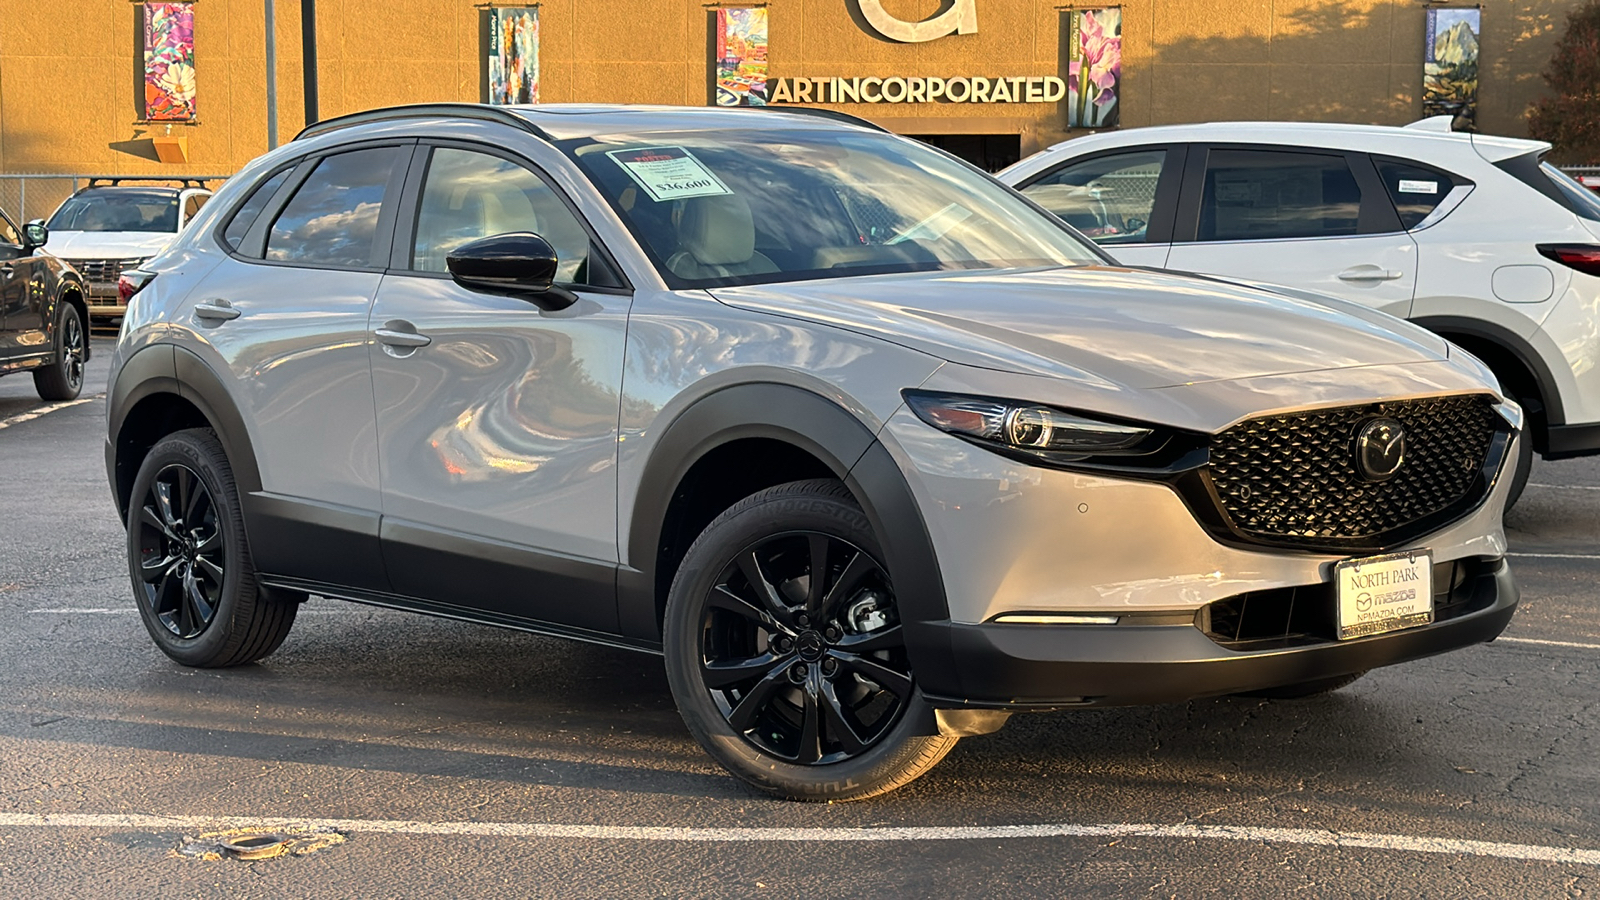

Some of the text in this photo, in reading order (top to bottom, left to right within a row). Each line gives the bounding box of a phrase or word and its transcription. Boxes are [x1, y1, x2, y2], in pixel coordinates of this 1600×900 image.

[656, 179, 712, 191] $36,600
[1351, 566, 1419, 590] NORTH PARK
[1357, 605, 1415, 622] NPMAZDACOM
